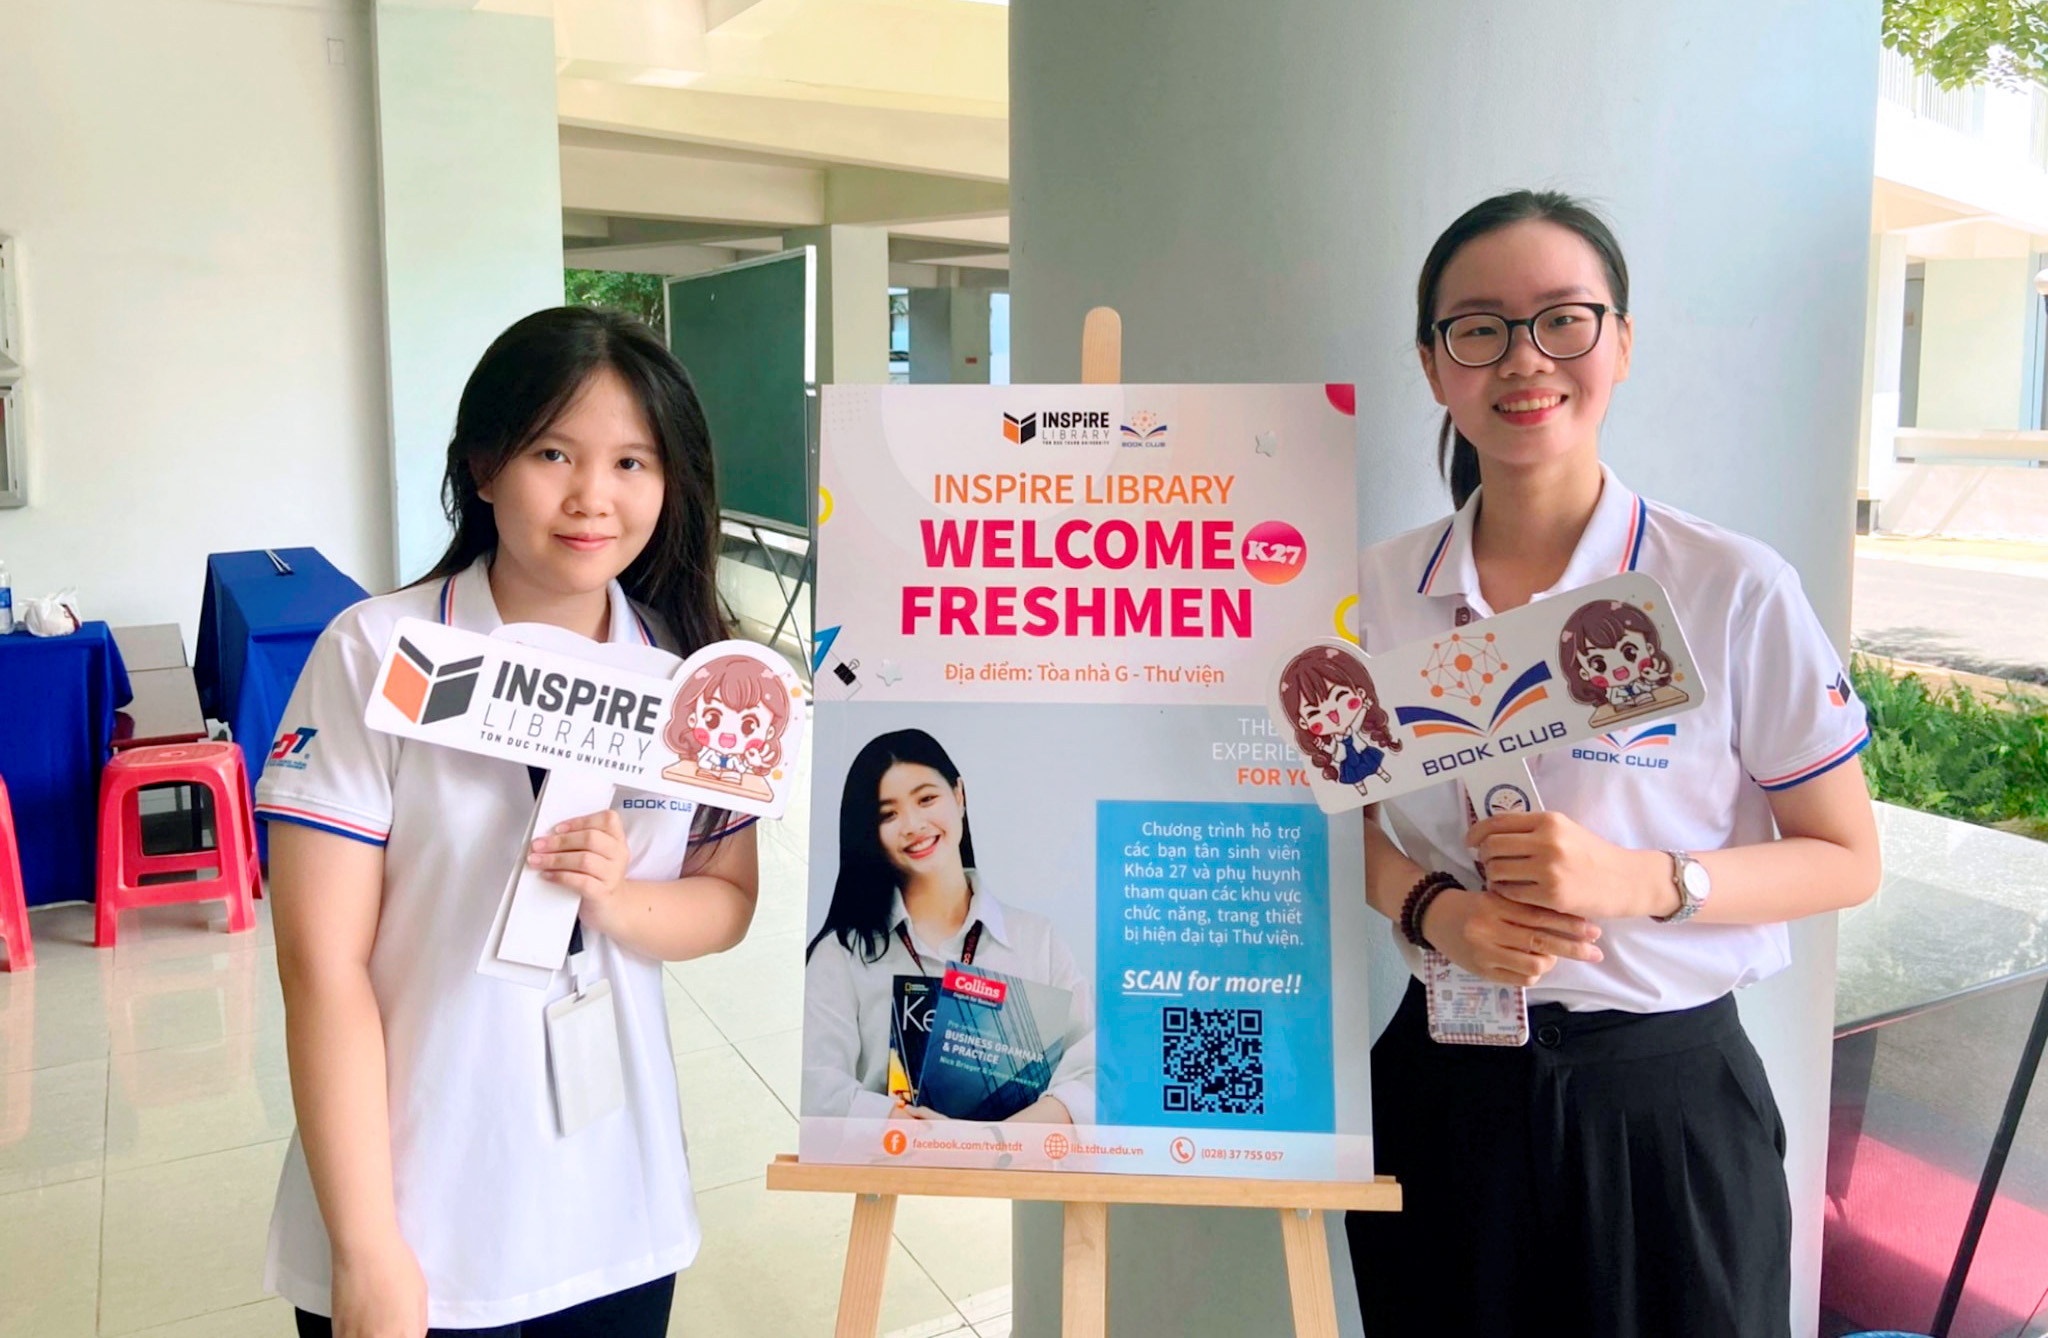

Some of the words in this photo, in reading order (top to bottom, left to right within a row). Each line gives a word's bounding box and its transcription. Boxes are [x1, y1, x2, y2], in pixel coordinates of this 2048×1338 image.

[1042, 411, 1110, 429] INSPiRE
[1042, 429, 1110, 440] LIBRARY
[934, 472, 1074, 504] INSPiRE
[1085, 474, 1235, 504] LIBRARY
[919, 519, 1236, 570] WELCOME
[1246, 540, 1302, 566] K27
[901, 585, 1253, 638] FRESHMEN
[945, 663, 975, 685] Địa
[979, 661, 1033, 682] điểm:
[1037, 663, 1071, 682] Tòa
[1075, 662, 1108, 682] nhà
[1114, 665, 1129, 682] G
[1144, 664, 1182, 683] Thư
[1185, 664, 1225, 687] viện
[492, 660, 663, 735] INSPiRE
[483, 702, 652, 761] LIBRARY
[480, 730, 502, 743] TON
[507, 736, 531, 749] DUC
[535, 743, 572, 759] THANG
[576, 753, 645, 775] UNIVERSITY
[1212, 741, 1300, 761] EXPERIE
[1422, 742, 1494, 776] BOOK
[1498, 721, 1568, 753] CLUB
[1571, 748, 1620, 764] BOOK
[1625, 754, 1669, 769] CLUB
[1237, 767, 1282, 786] FOR
[623, 799, 667, 810] BOOK
[1142, 822, 1202, 840] Chương
[1208, 822, 1244, 837] trình
[1252, 822, 1271, 838] hỗ
[1278, 826, 1300, 843] trợ
[1125, 841, 1149, 856] các
[1158, 843, 1186, 861] bạn
[1195, 844, 1219, 858] tân
[1228, 845, 1260, 859] sinh
[1268, 845, 1300, 860] viên
[1125, 862, 1163, 877] Khóa
[1169, 865, 1186, 878] 27
[1193, 864, 1209, 879] và
[1216, 867, 1246, 883] phụ
[1252, 866, 1300, 885] huynh
[1125, 884, 1164, 899] tham
[1168, 888, 1207, 904] quan
[1212, 885, 1237, 901] các
[1241, 886, 1269, 902] khu
[1274, 889, 1301, 906] vực
[1125, 905, 1161, 920] chức
[1168, 907, 1211, 925] năng,
[1218, 909, 1259, 926] trang
[1266, 908, 1302, 924] thiết
[1125, 927, 1138, 944] bị
[1143, 928, 1176, 946] hiện
[1181, 928, 1204, 946] đại
[1209, 929, 1228, 947] tại
[1232, 930, 1262, 944] Thư
[1267, 931, 1304, 949] viện.
[955, 976, 1000, 998] Collins
[1122, 969, 1182, 991] SCAN
[1188, 970, 1221, 992] for
[1225, 974, 1302, 995] more!!
[902, 995, 937, 1033] Ke
[942, 1042, 950, 1052] &
[952, 1044, 1000, 1065] PRACTICE
[945, 1029, 993, 1050] BUSINESS
[994, 1043, 1044, 1064] GRAMMAR
[1201, 1148, 1227, 1160] (028)
[1229, 1149, 1242, 1159] 37
[1244, 1149, 1263, 1160] 755
[1265, 1151, 1284, 1161] 057
